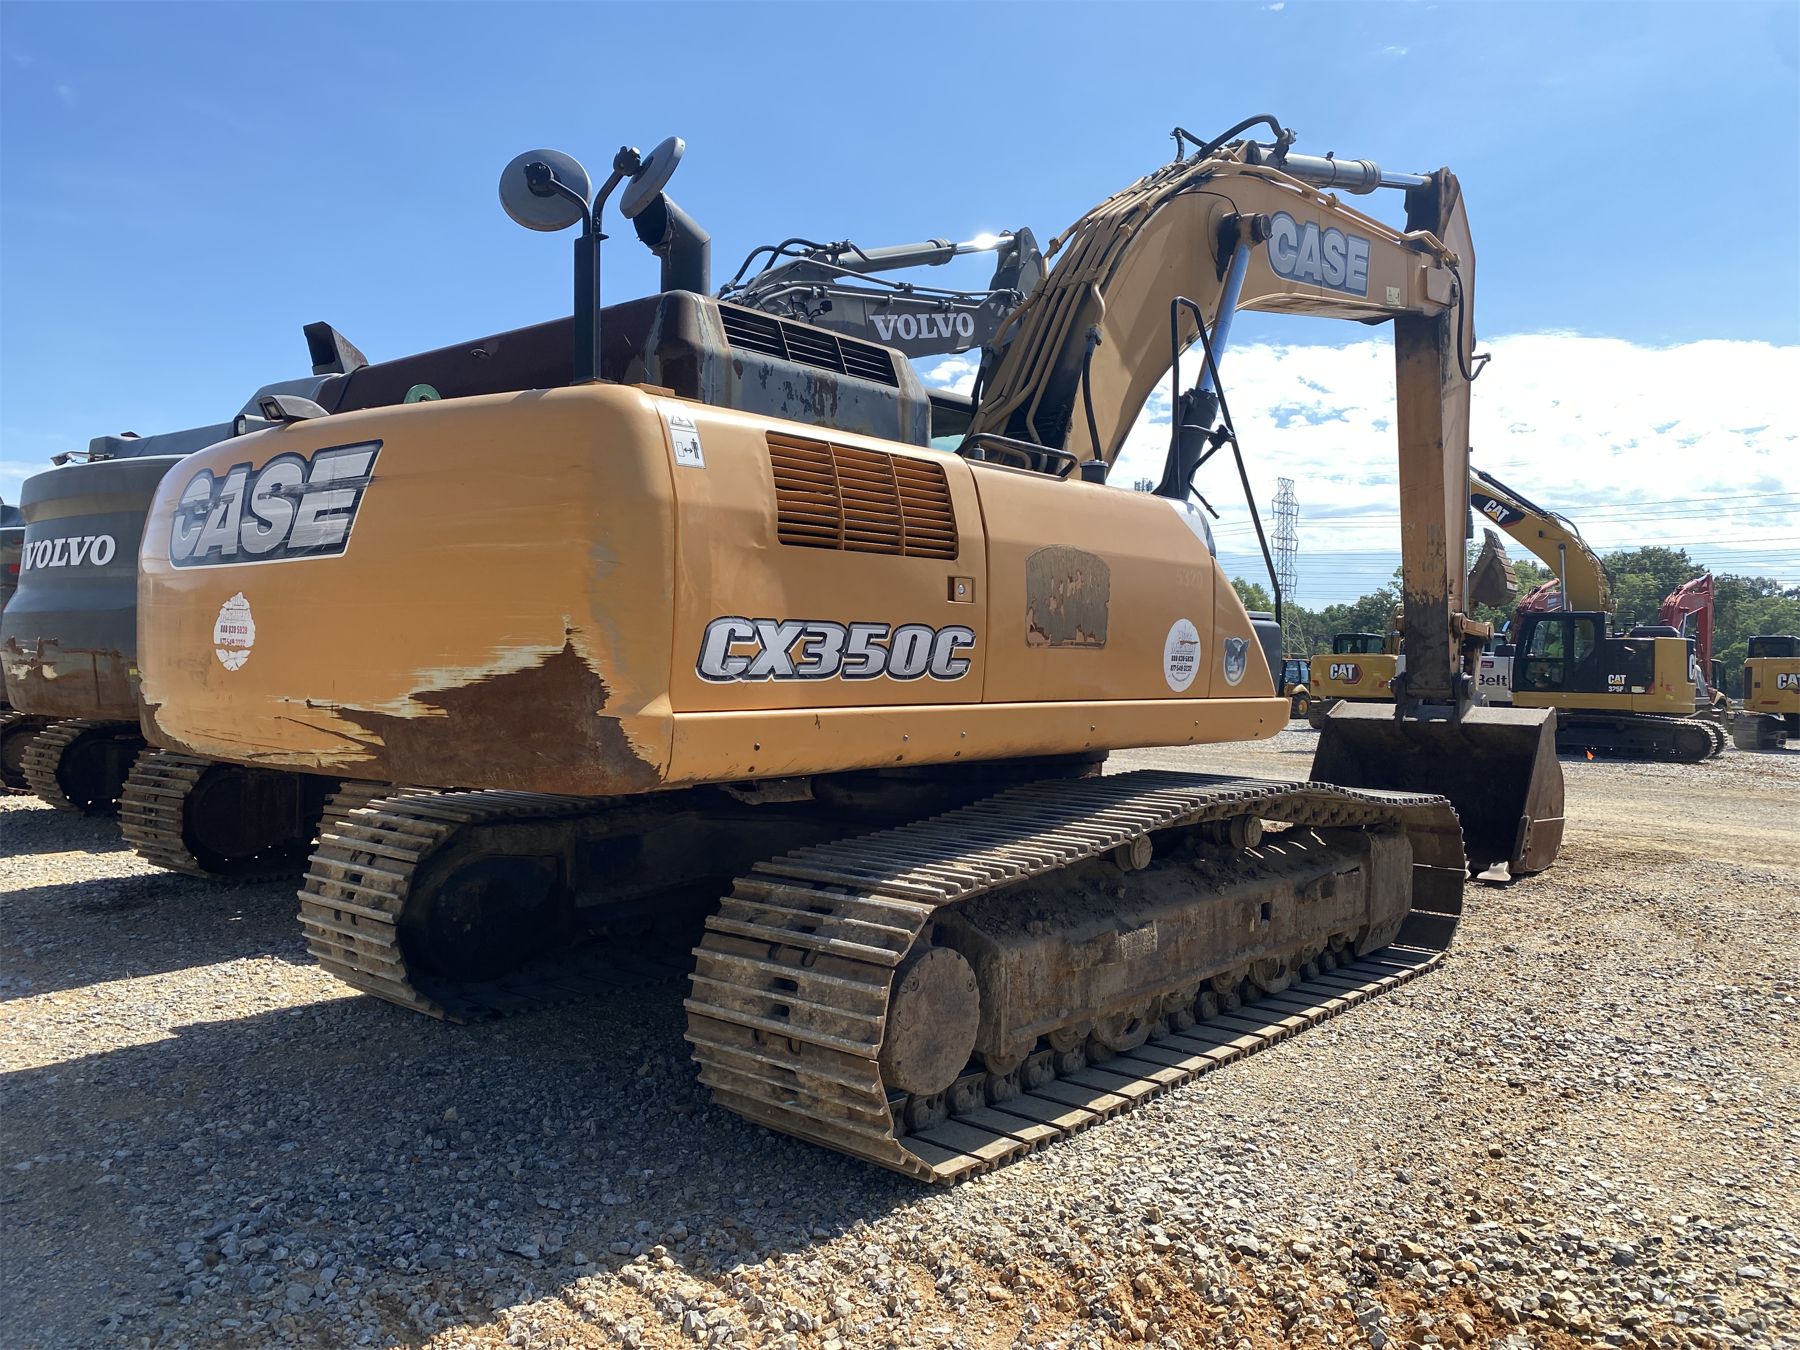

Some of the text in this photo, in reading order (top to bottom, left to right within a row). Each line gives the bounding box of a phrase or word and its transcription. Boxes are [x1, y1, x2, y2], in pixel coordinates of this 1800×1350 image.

[1268, 214, 1369, 291] CASE
[869, 312, 975, 340] VOLVO
[171, 450, 376, 561] CASE
[1483, 500, 1510, 522] CAT
[24, 534, 116, 570] VOLVO
[698, 620, 976, 679] CX350C
[1329, 663, 1355, 680] CAT
[1607, 674, 1627, 685] CAT
